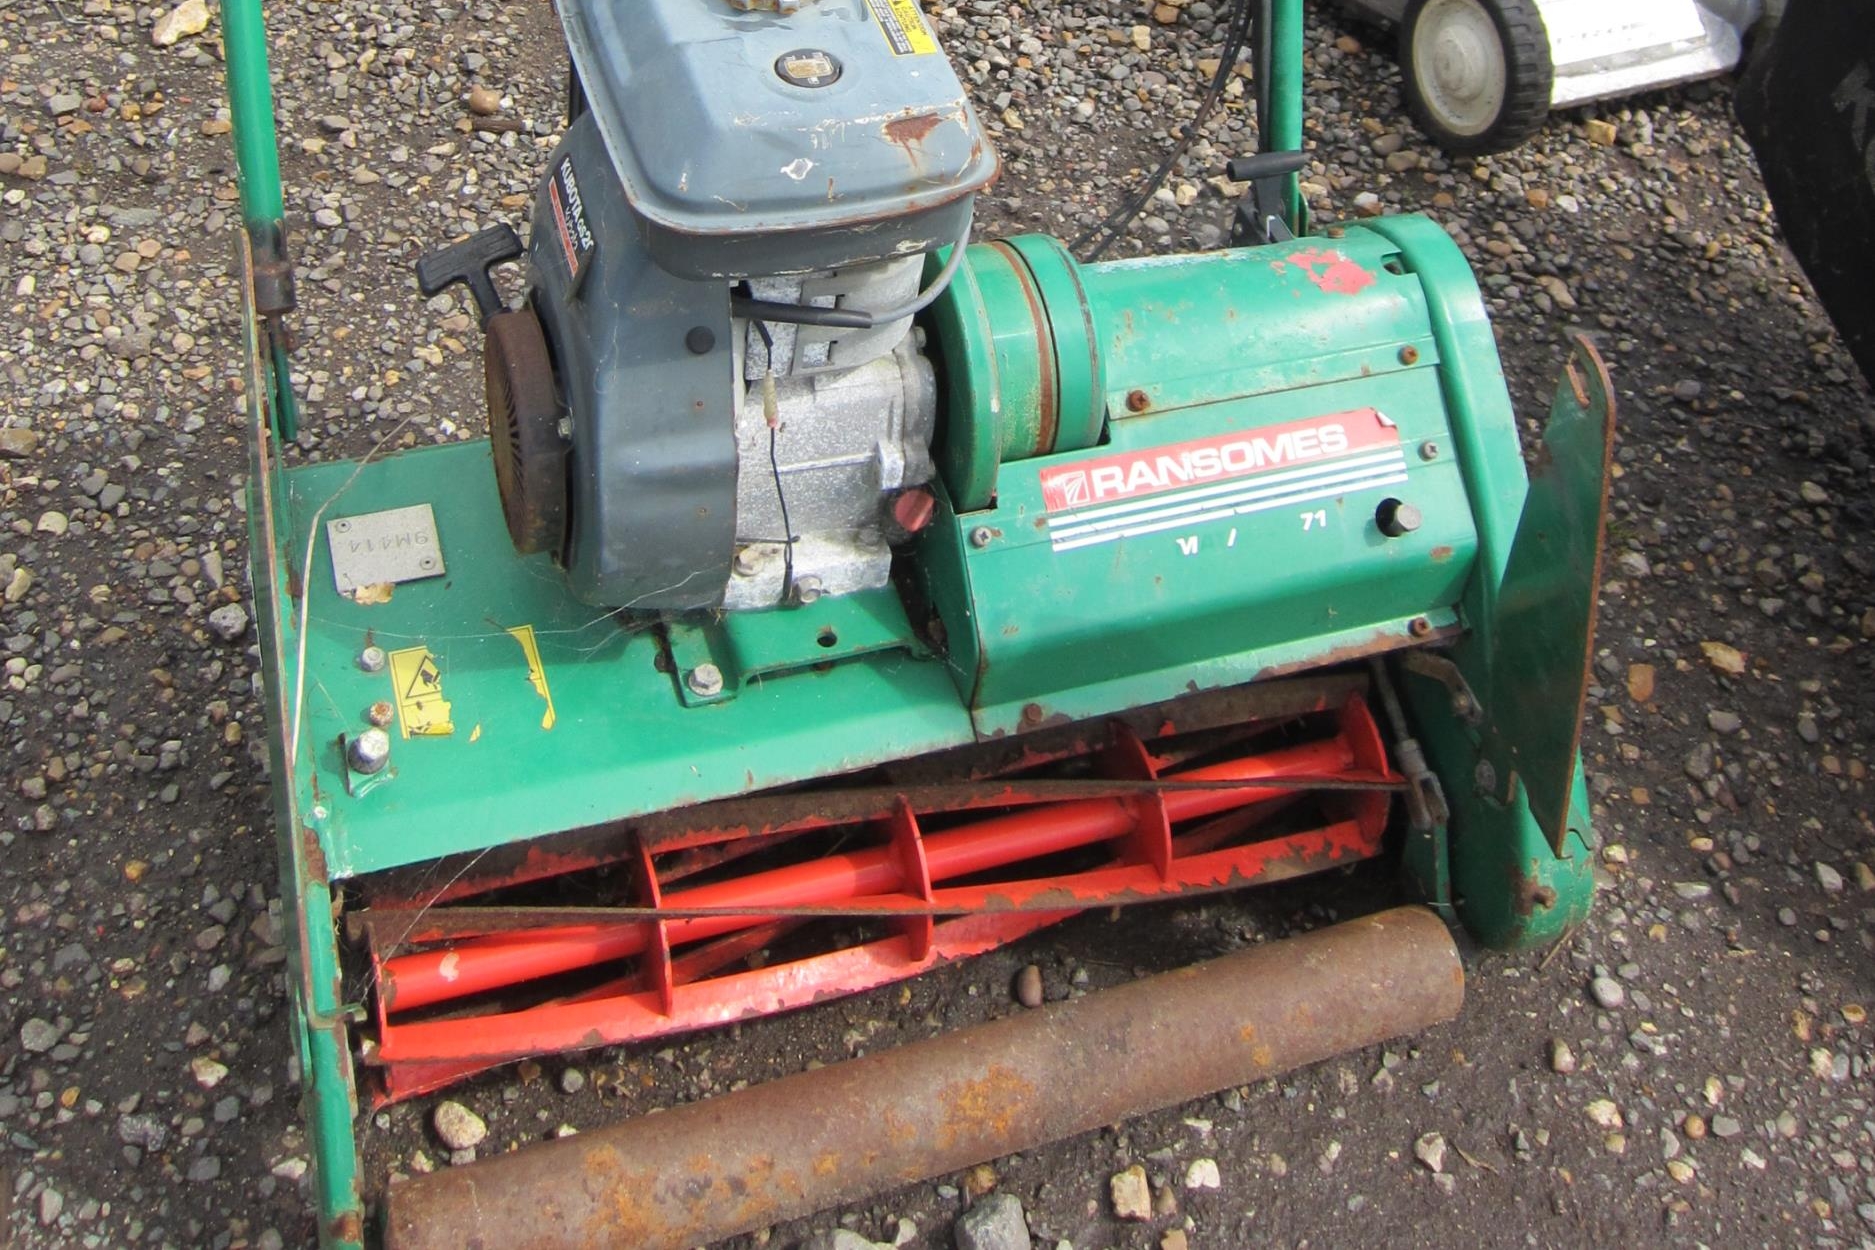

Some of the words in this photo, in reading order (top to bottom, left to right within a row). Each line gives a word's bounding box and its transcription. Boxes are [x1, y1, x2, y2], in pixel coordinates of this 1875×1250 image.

[561, 157, 583, 223] KUBOTA
[1093, 424, 1348, 498] RANSOMES
[1300, 509, 1327, 531] 71
